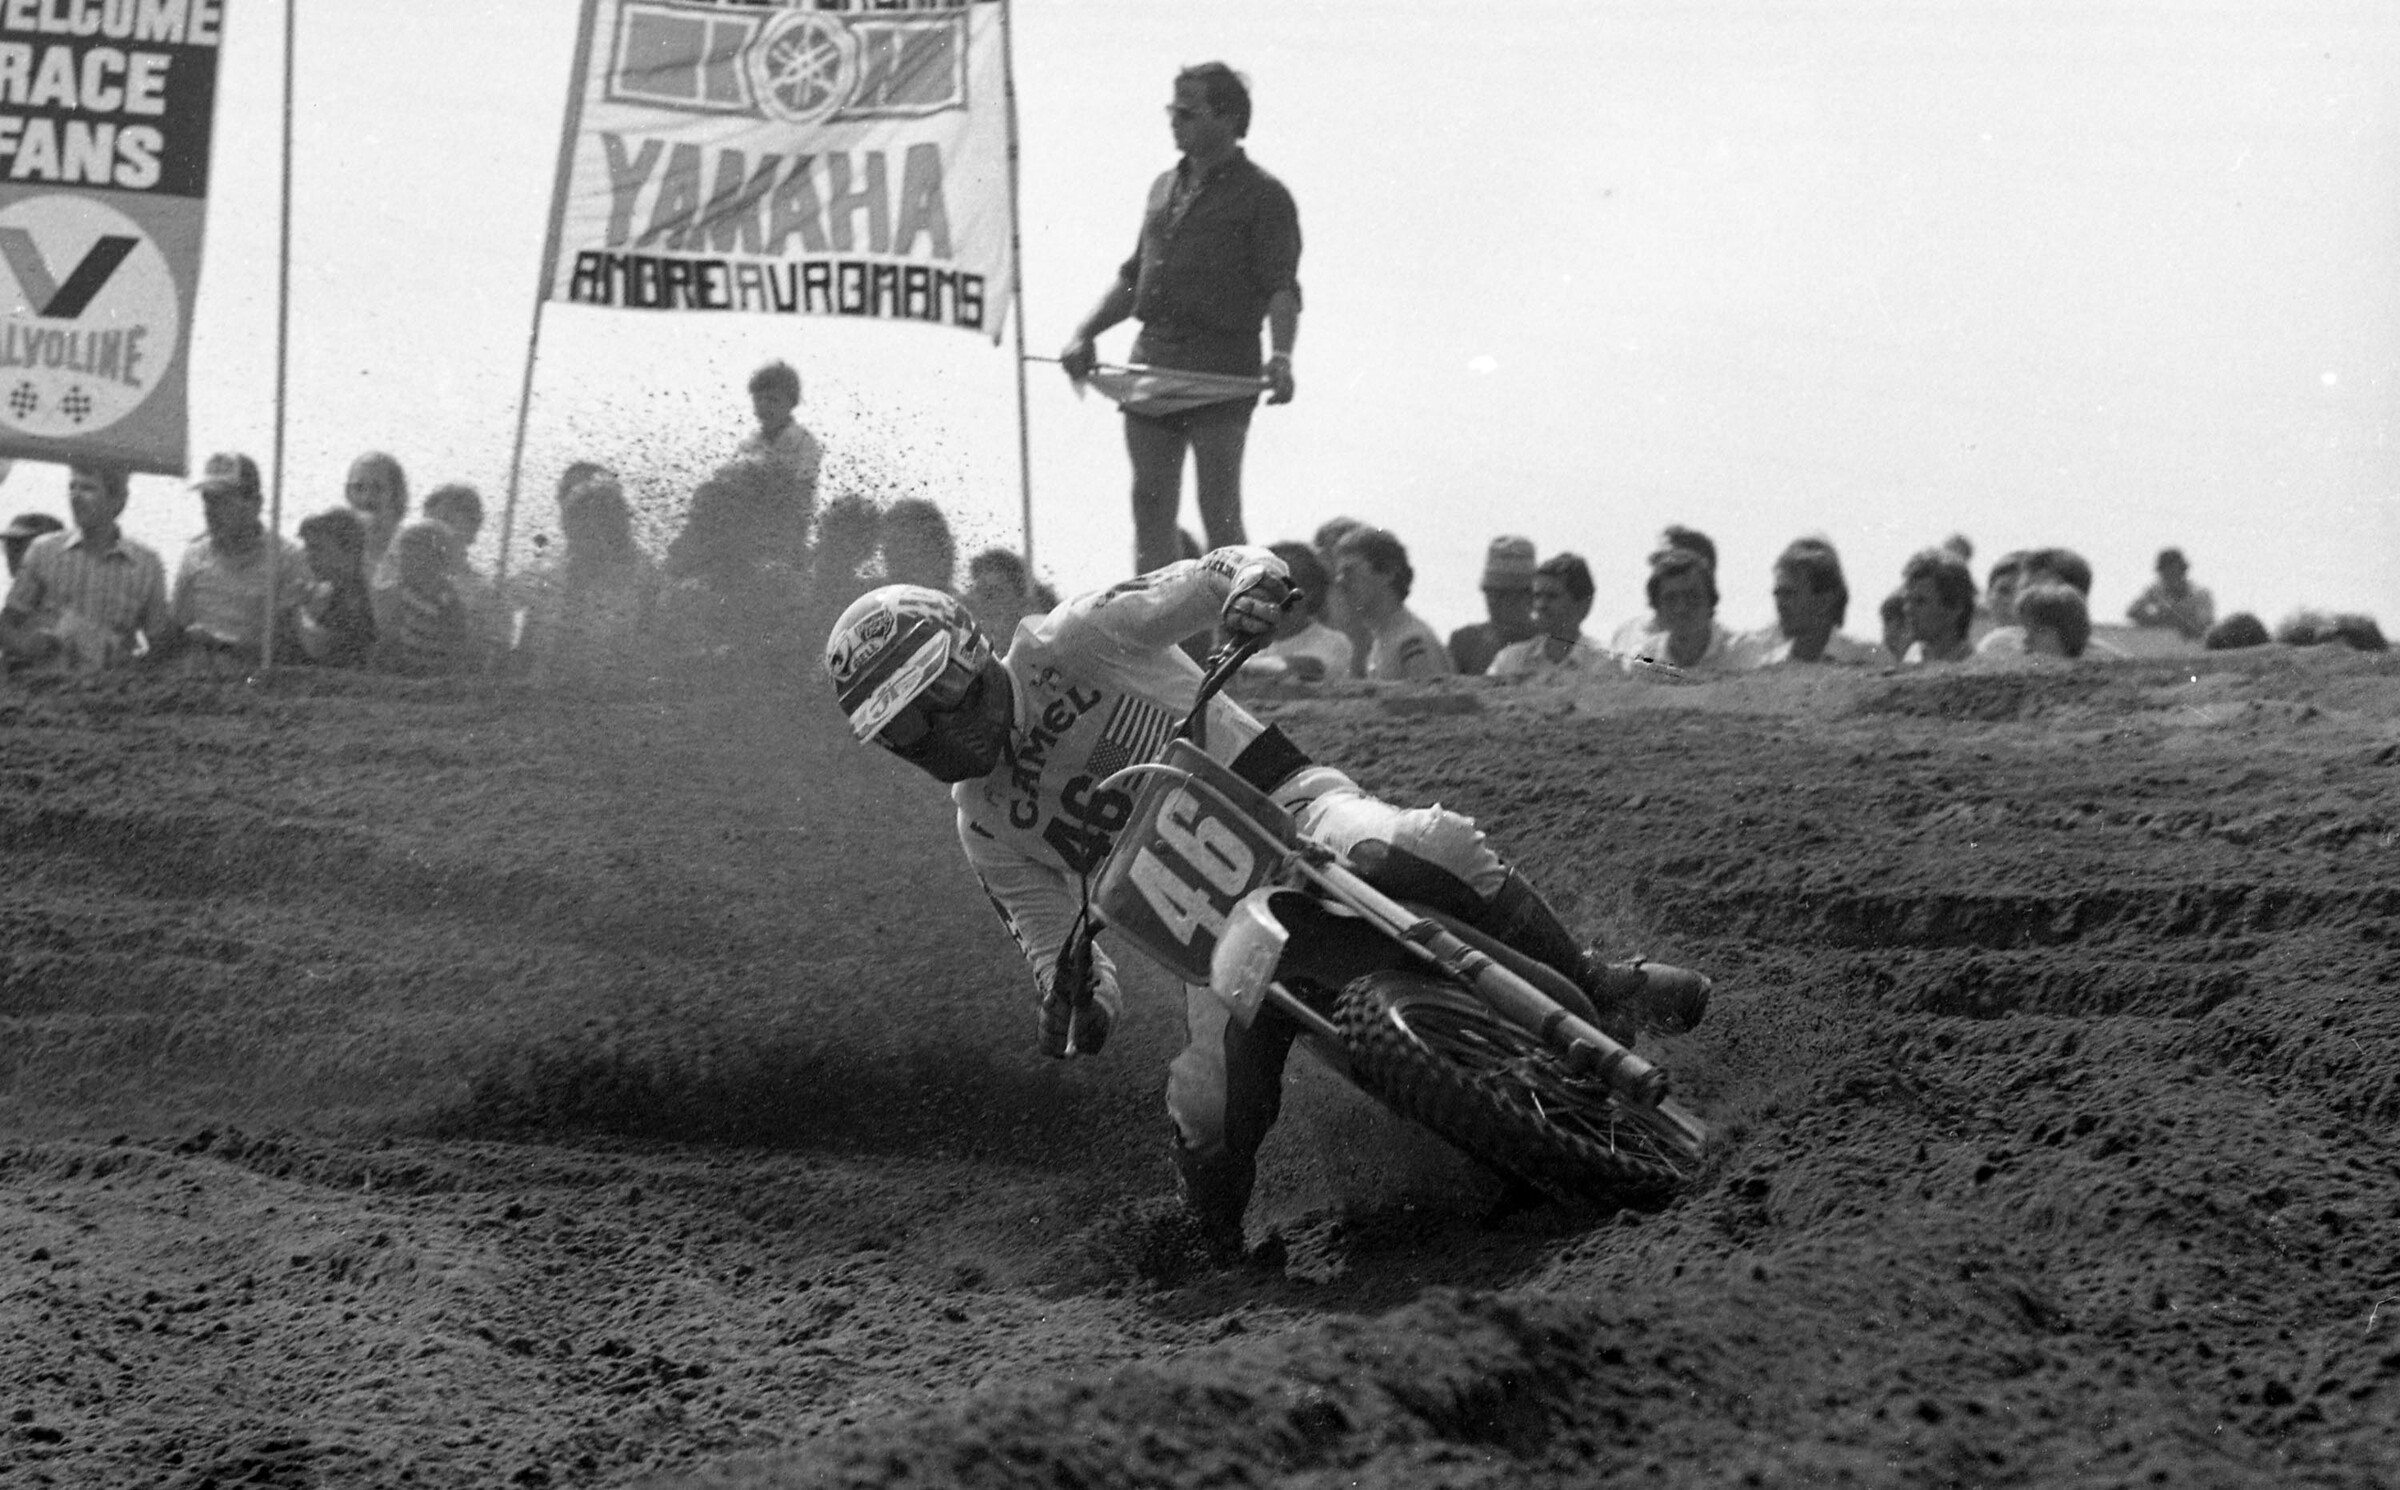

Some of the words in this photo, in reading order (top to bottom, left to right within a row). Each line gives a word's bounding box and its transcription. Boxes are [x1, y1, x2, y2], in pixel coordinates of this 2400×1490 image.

[0, 0, 221, 45] ELCOME
[0, 42, 172, 115] RACE
[600, 132, 953, 260] YAMAHA
[0, 323, 148, 388] LVOLINE
[1009, 686, 1102, 830] CAMEL
[1042, 775, 1134, 874] 46
[1128, 786, 1255, 946] 46
